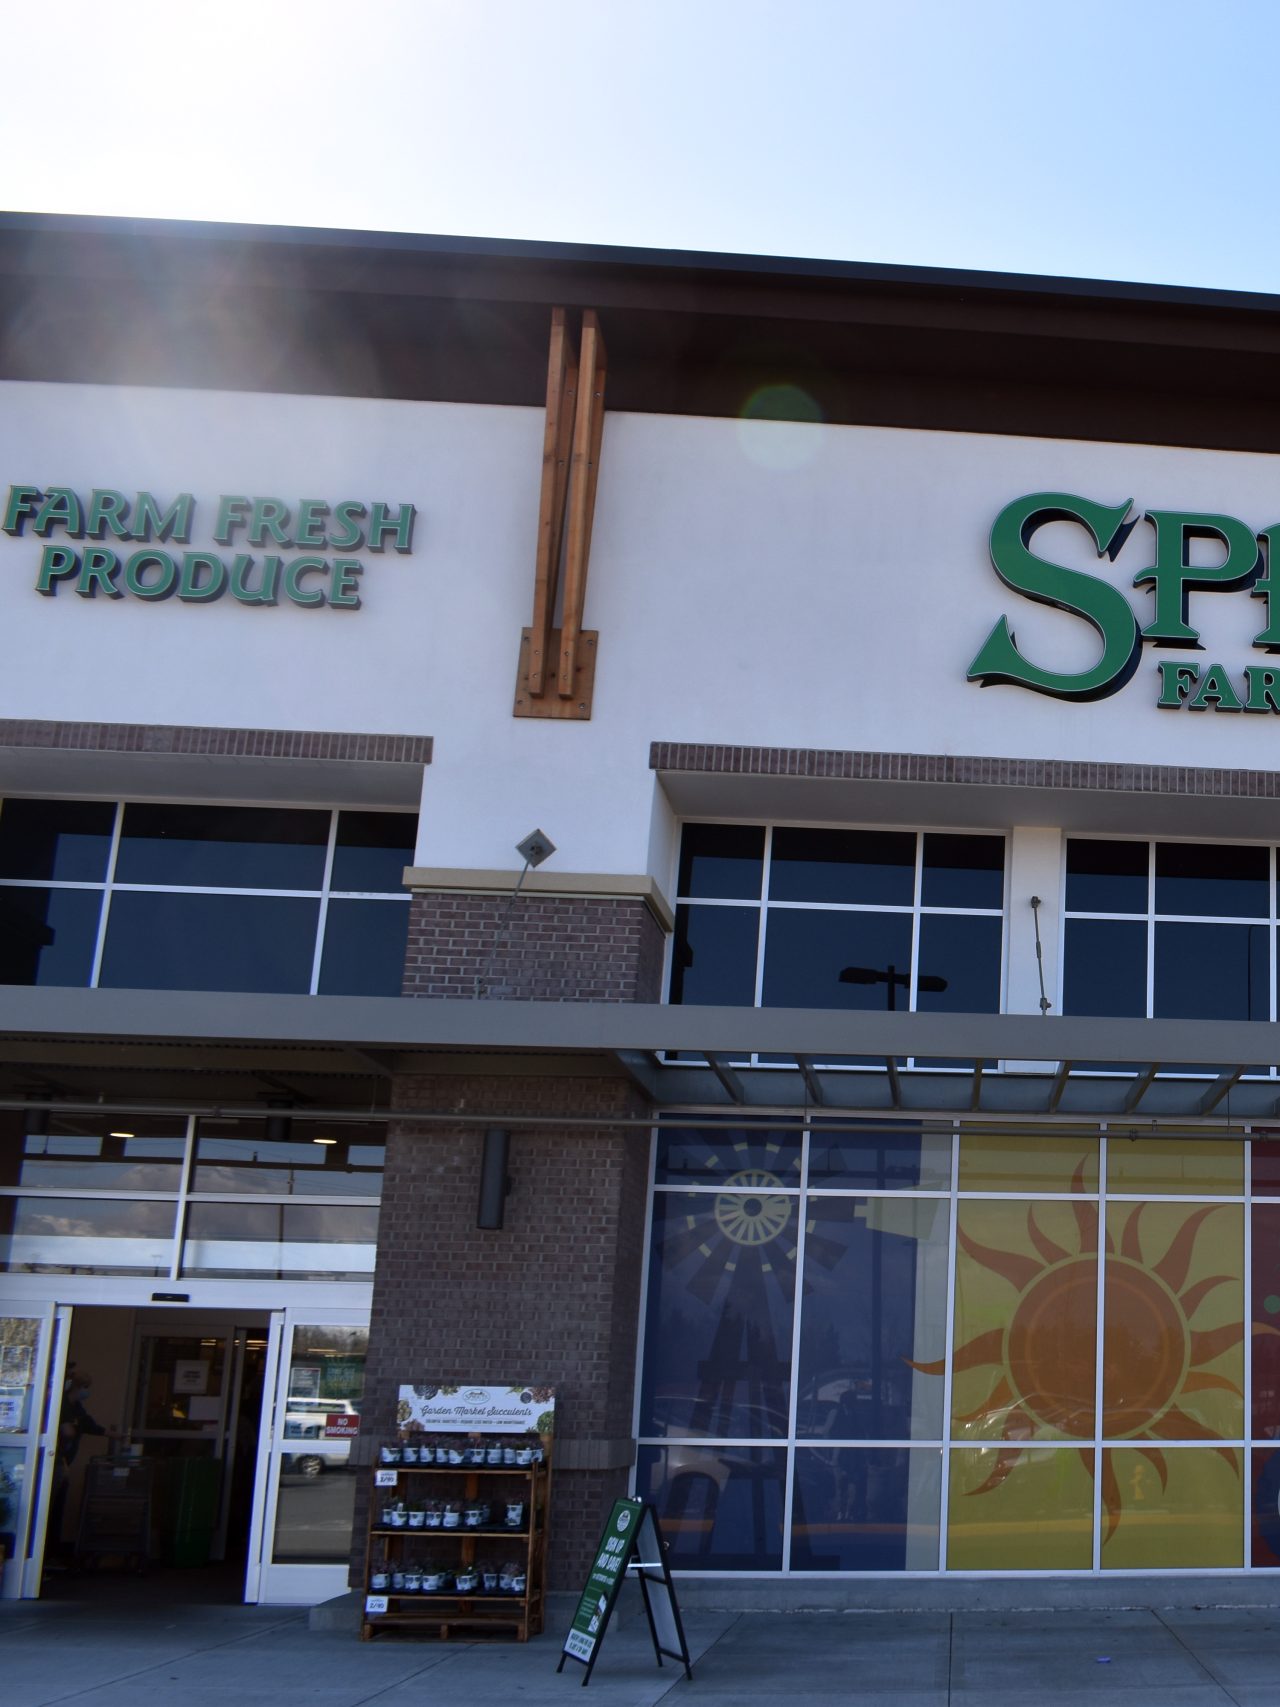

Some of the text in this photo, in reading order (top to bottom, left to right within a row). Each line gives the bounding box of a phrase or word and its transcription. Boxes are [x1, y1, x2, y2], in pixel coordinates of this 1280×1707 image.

[2, 484, 417, 555] FARM FRESH
[35, 544, 364, 610] PRODUCE
[420, 1405, 533, 1417] Garden Market Succulents
[337, 1417, 348, 1426] NO
[326, 1426, 358, 1435] SMOKING
